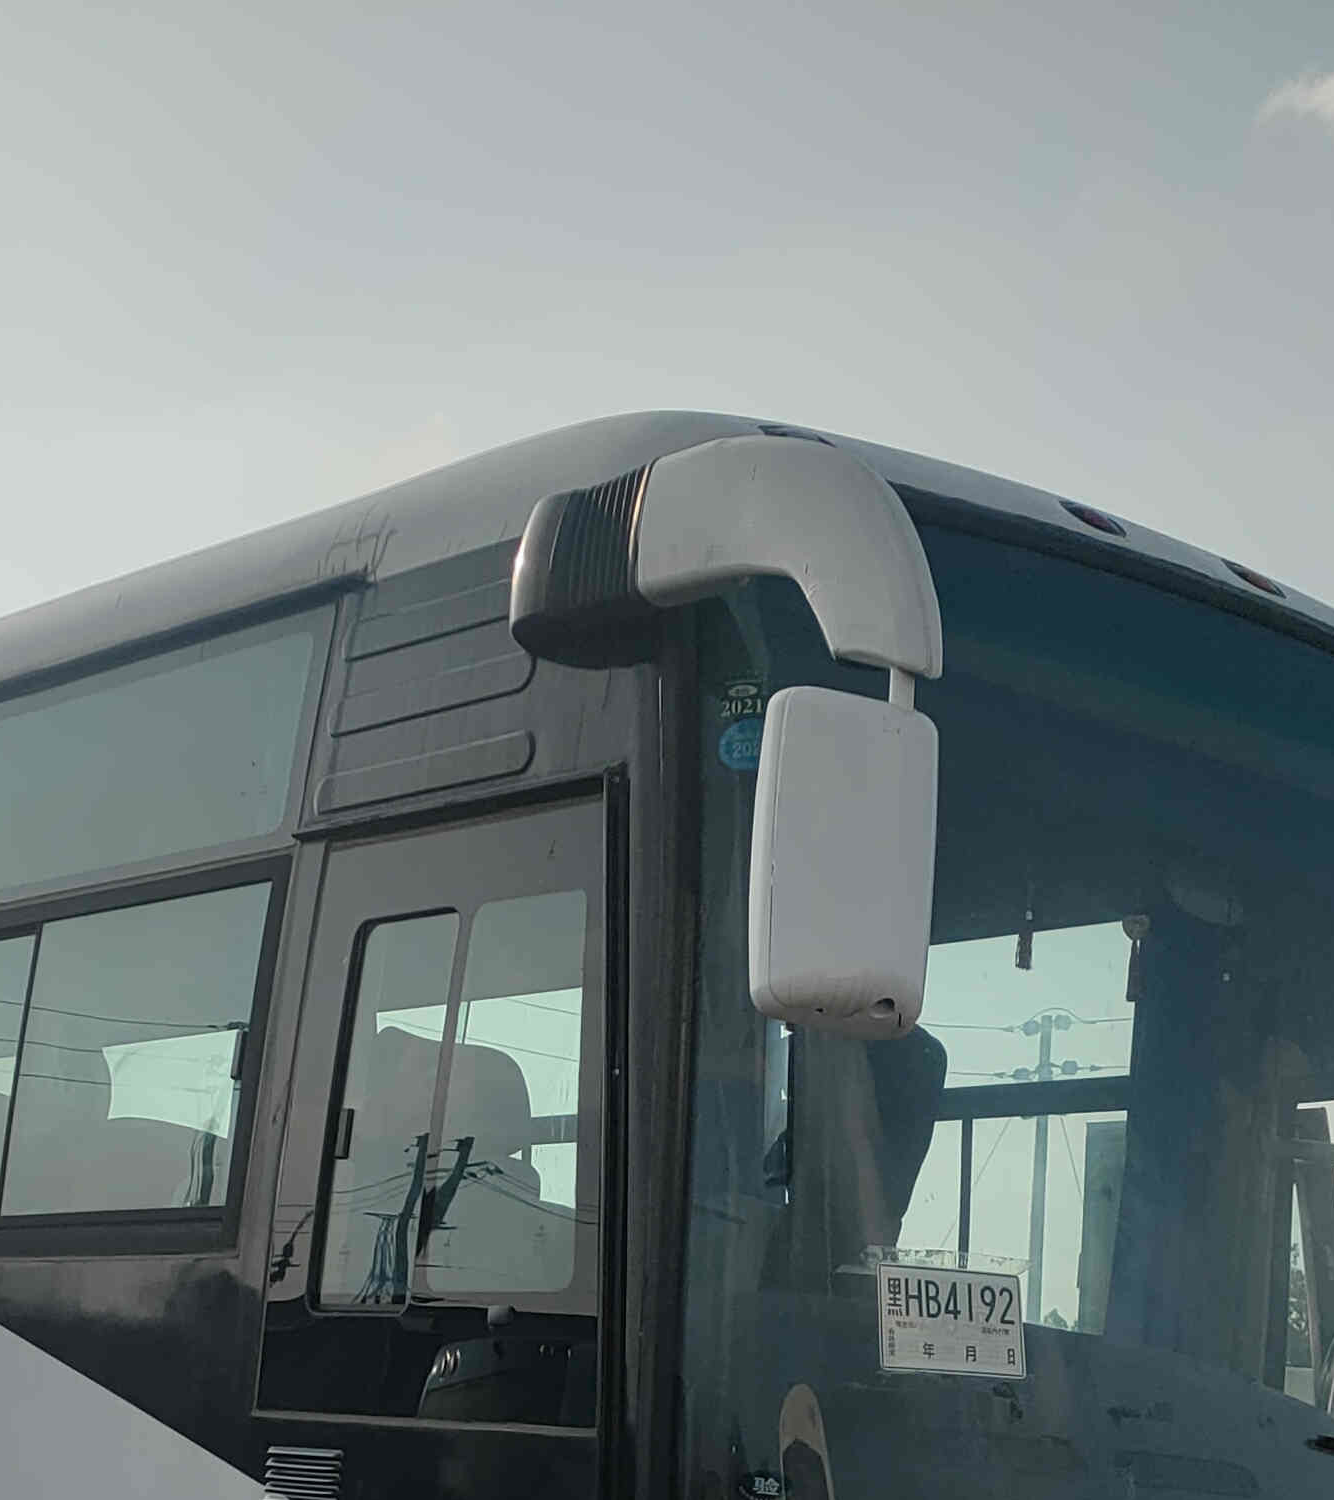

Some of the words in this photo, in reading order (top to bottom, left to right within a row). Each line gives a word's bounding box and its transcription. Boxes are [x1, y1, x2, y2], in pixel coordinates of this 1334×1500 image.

[720, 698, 763, 717] 2021
[887, 1277, 1015, 1325] 黑HB4192
[923, 1342, 935, 1359] 年
[965, 1345, 977, 1363] 月
[1007, 1348, 1016, 1366] 日
[752, 1476, 779, 1496] 验
